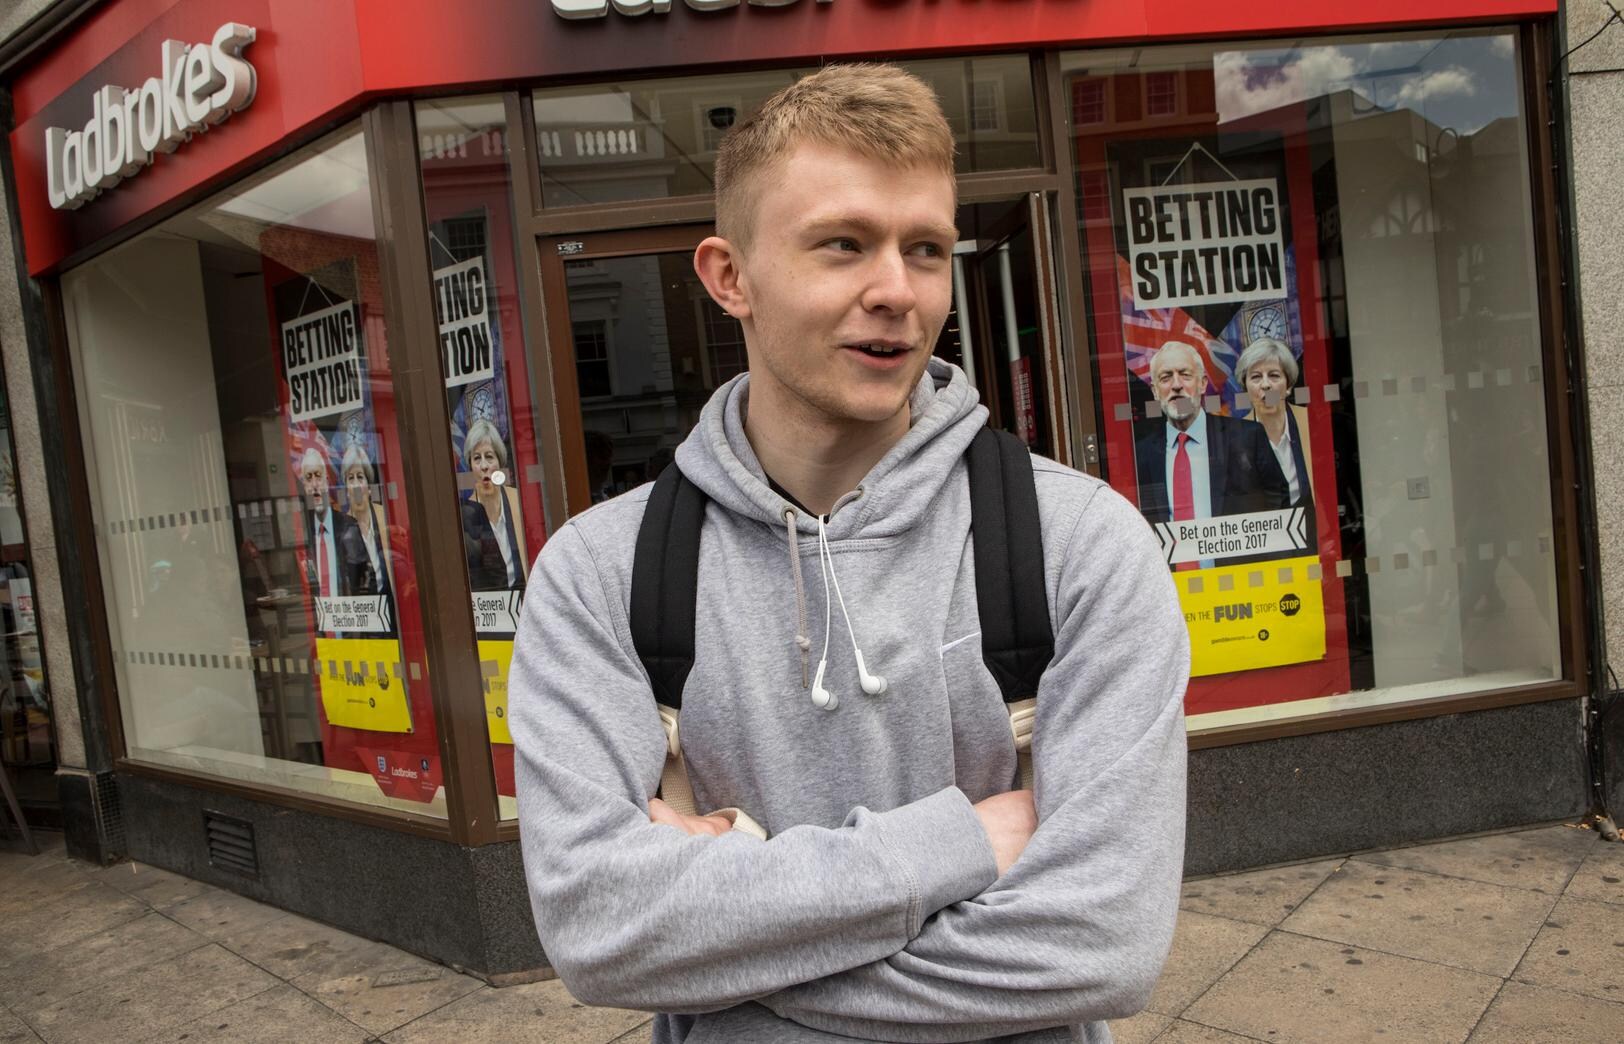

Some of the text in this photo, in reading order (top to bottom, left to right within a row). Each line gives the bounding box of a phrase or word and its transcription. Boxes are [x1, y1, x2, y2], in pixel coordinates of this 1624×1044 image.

[45, 22, 257, 210] Ladbrokes
[1129, 187, 1277, 245] BETTING
[1135, 242, 1282, 301] STATION
[285, 309, 353, 369] BETTING
[290, 358, 361, 415] STATION
[1180, 515, 1282, 541] Bet on the General
[1198, 533, 1267, 555] Election 2017
[477, 595, 506, 611] General
[1198, 610, 1211, 621] THE
[1214, 602, 1253, 623] FUN
[1254, 602, 1278, 614] STOPS
[1280, 600, 1300, 611] STOP
[481, 612, 497, 627] 2017
[391, 766, 418, 779] Ladbrokes
